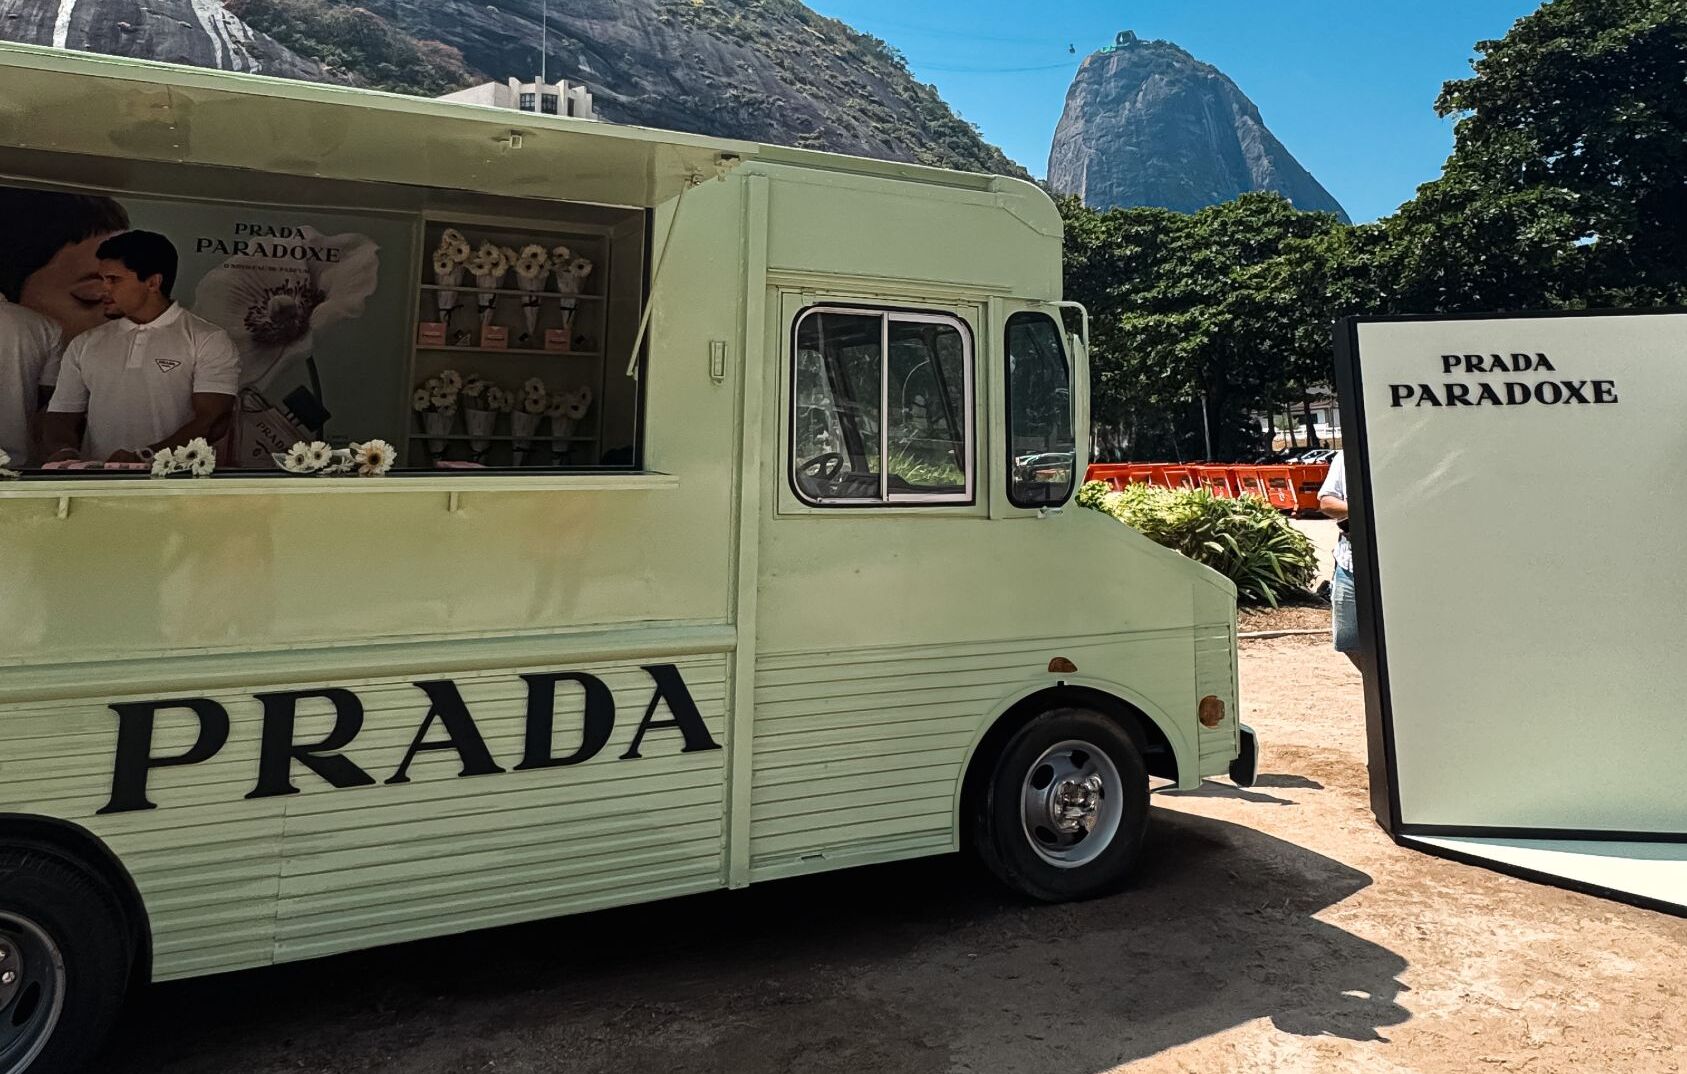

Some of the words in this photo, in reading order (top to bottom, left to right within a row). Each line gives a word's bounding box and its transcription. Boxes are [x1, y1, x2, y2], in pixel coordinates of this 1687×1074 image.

[234, 222, 305, 240] PRADA
[196, 238, 340, 263] PARADOXE
[1441, 353, 1556, 373] PRADA
[1388, 380, 1619, 408] PARADOXE
[256, 421, 285, 450] PRAD
[95, 663, 723, 815] PRADA
